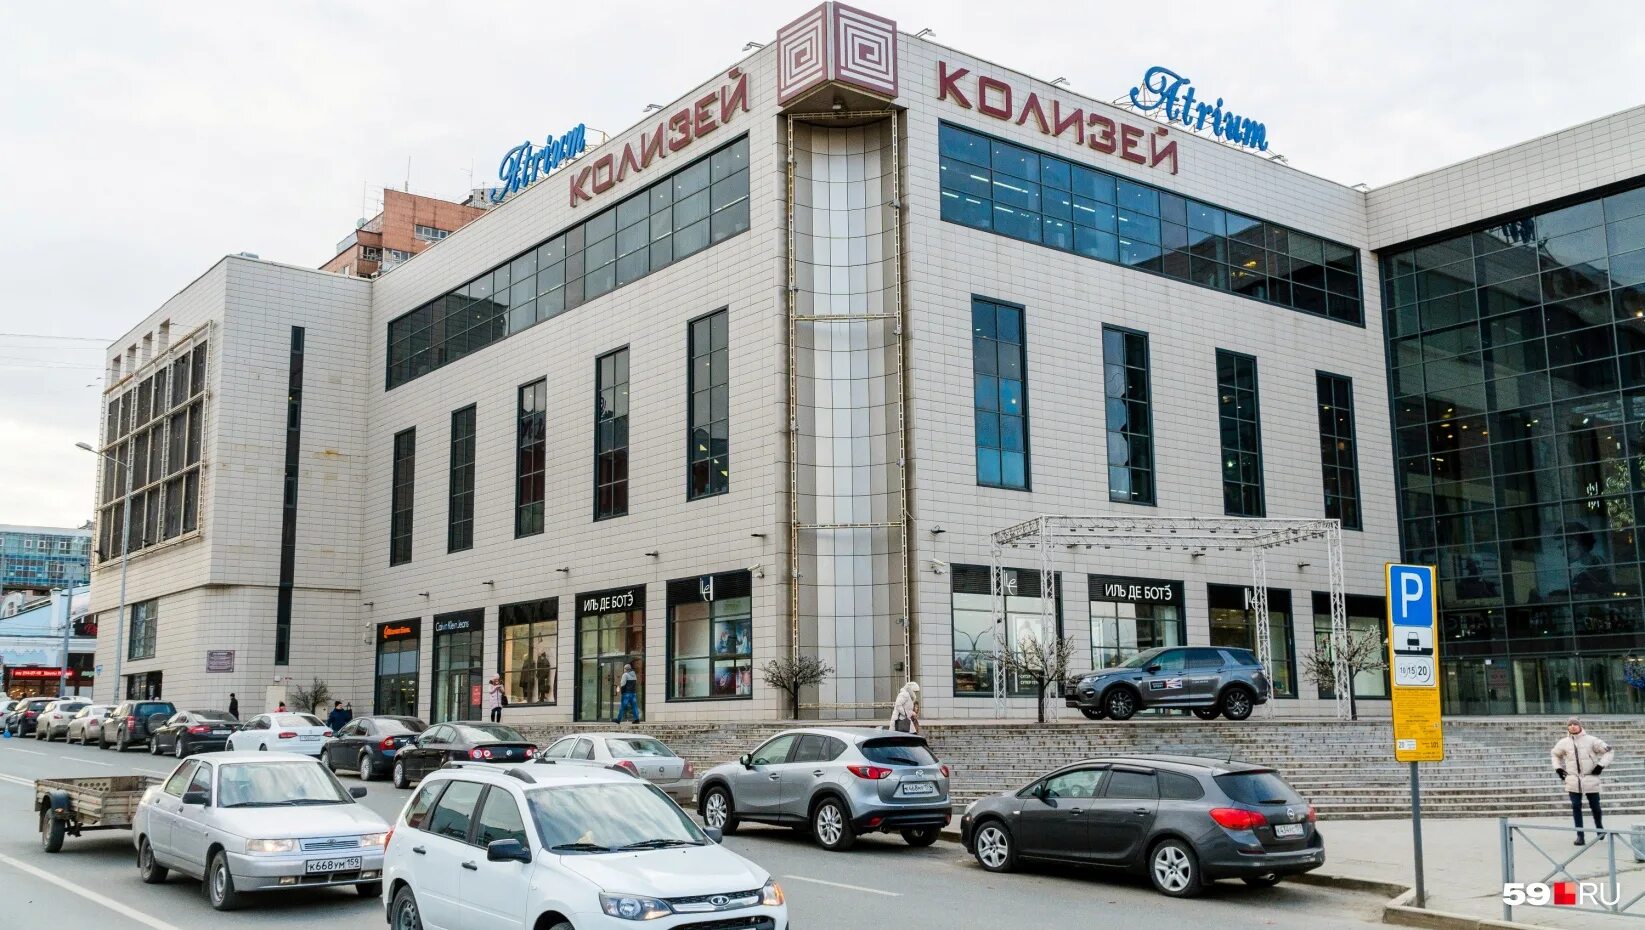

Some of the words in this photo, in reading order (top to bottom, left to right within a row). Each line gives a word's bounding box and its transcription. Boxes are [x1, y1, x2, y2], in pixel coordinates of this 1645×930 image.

[937, 60, 1178, 176] КОЛИЗЕЙ
[1130, 66, 1268, 151] Atrium
[569, 66, 751, 208] КОЛИЗЕЙ
[490, 123, 585, 204] Atrium
[584, 599, 599, 612] ИЛЬ
[600, 596, 610, 611] ДЕ
[1105, 584, 1126, 597] ИЛЬ
[1128, 586, 1141, 600] ДЕ
[1400, 572, 1423, 618] P
[1408, 666, 1415, 675] 15
[1417, 665, 1428, 676] 20
[346, 858, 359, 866] 159
